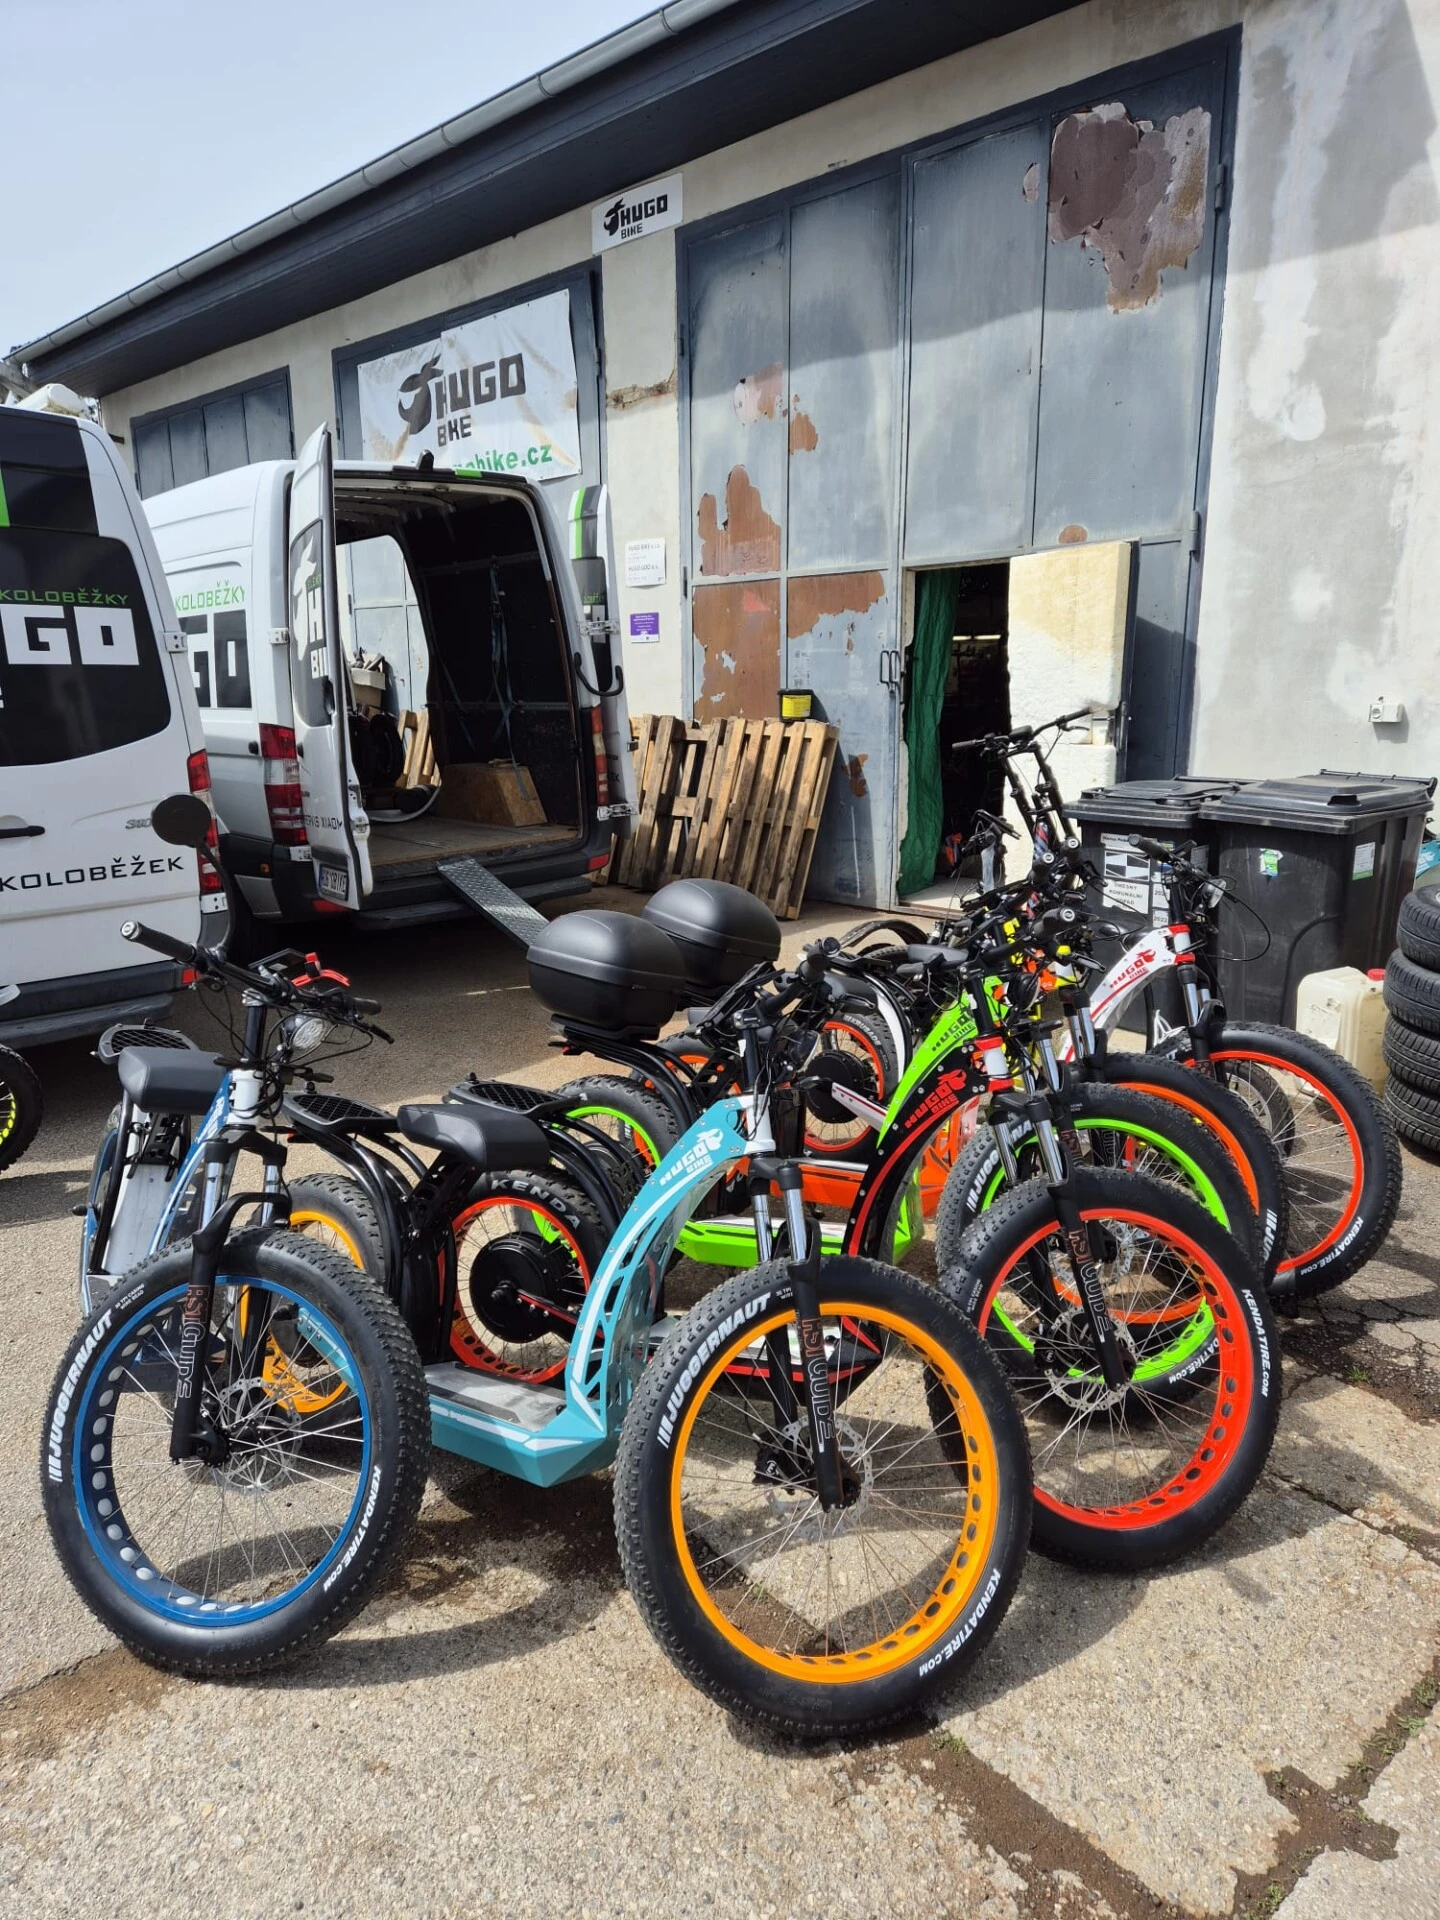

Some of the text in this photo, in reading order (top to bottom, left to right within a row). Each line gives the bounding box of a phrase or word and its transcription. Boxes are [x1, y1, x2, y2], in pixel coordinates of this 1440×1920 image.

[620, 194, 668, 227] HUGO
[620, 222, 643, 239] BIKE
[434, 353, 526, 420] HUGO
[0, 588, 128, 605] KOLOBĚŽKY
[175, 580, 246, 612] KOLOBĚŽKY
[0, 855, 185, 893] KOLOBĚŽEK
[1109, 959, 1145, 989] HUGO
[932, 1012, 971, 1052] HUGO
[904, 1081, 953, 1129] HUGO
[930, 1093, 959, 1114] BIKE
[659, 1140, 709, 1186] HUGO
[685, 1154, 712, 1174] BIKE
[490, 1179, 581, 1230] KENDA
[1300, 1215, 1365, 1276] KENDATIRE.COM
[1241, 1289, 1271, 1398] KENDATIRE.COM
[323, 1464, 382, 1592] KENDATIRE.COM
[918, 1567, 1001, 1677] KENDATIRE.COM
